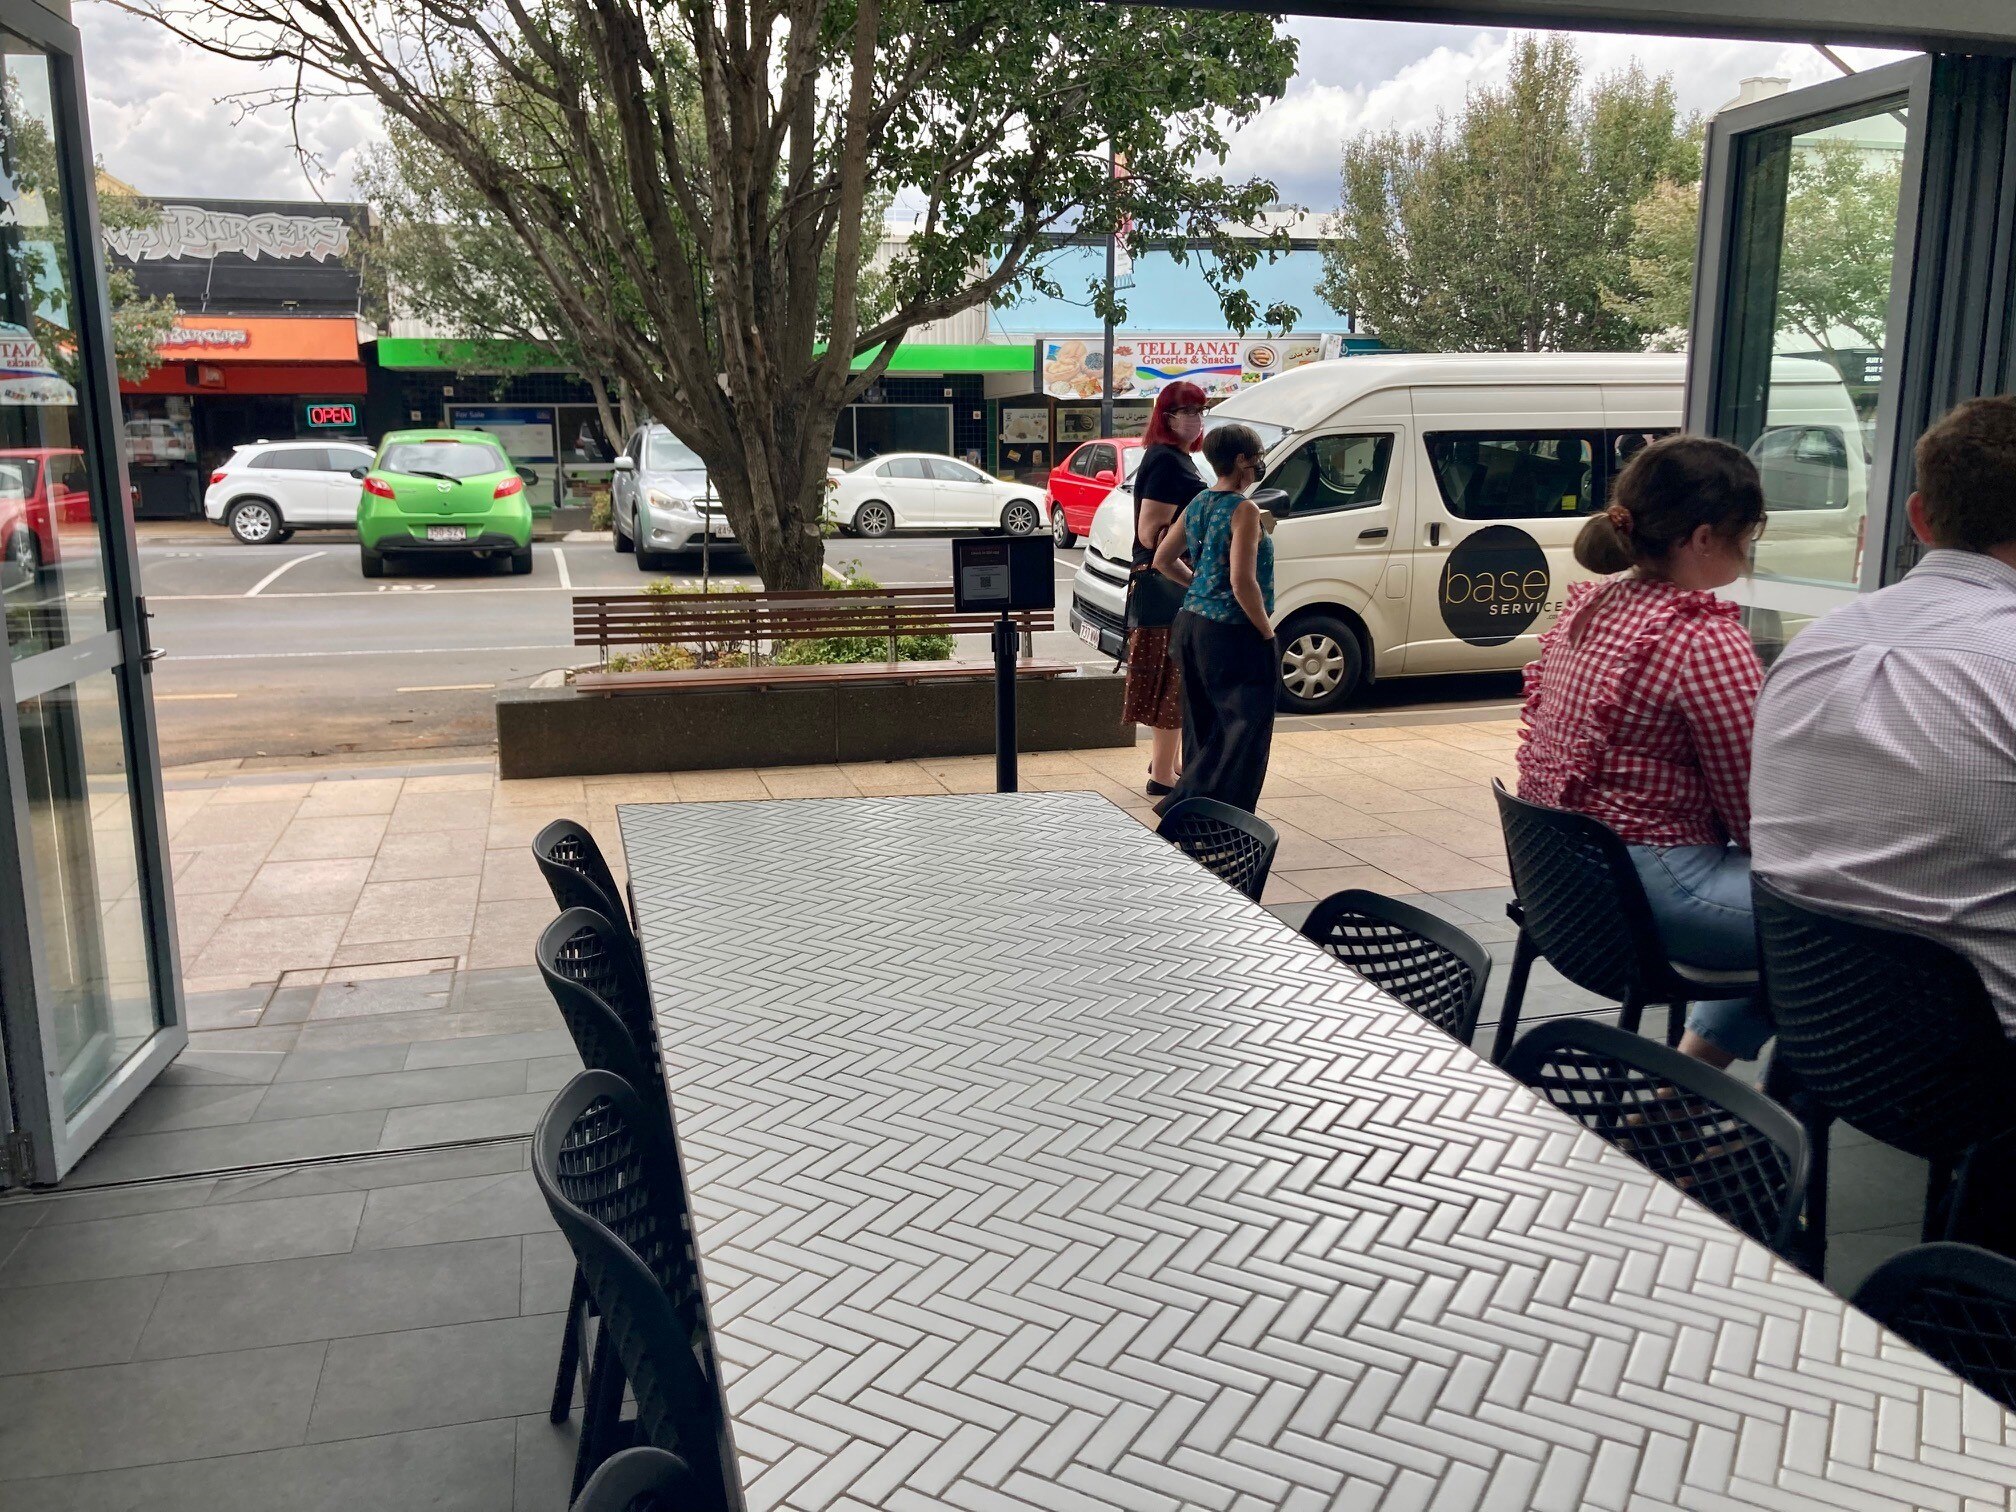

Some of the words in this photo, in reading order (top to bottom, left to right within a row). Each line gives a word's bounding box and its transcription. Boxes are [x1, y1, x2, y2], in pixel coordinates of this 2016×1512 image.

[1137, 342, 1181, 356] TELL
[1184, 342, 1240, 356] BANAT
[1142, 356, 1188, 365] Groceries
[1190, 356, 1199, 365] &
[1201, 356, 1235, 365] Snacks
[312, 407, 353, 425] OPEN
[1445, 563, 1548, 604] base
[1489, 601, 1563, 616] SERVICE
